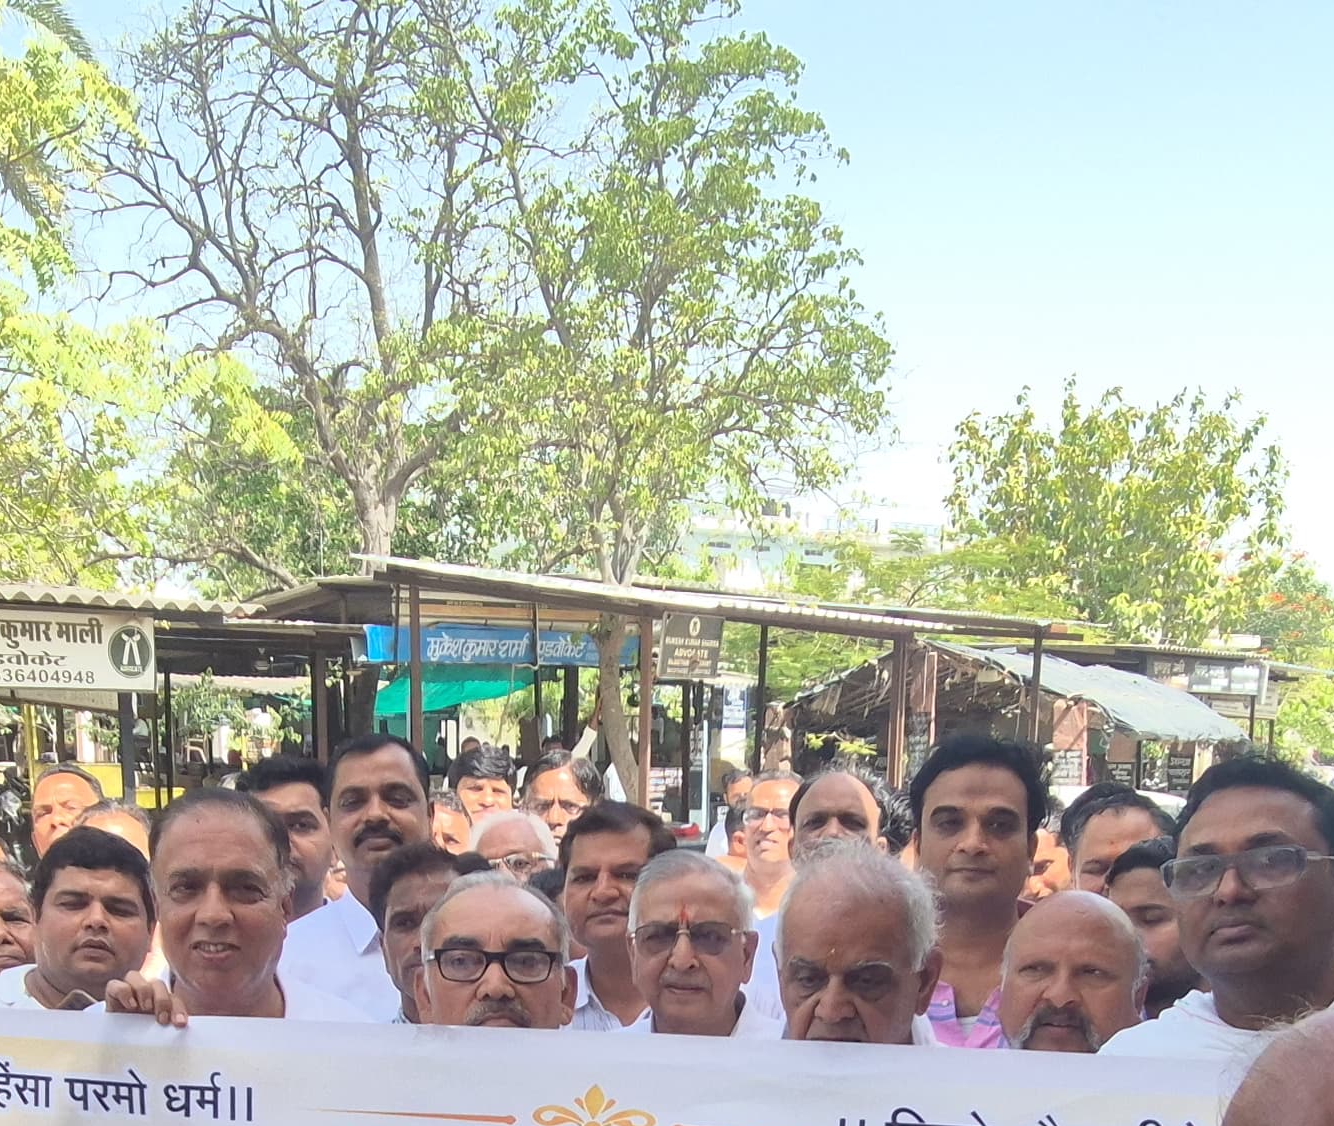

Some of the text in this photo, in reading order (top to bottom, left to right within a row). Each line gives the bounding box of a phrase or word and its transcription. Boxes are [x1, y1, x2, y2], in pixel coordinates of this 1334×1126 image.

[0, 618, 52, 648] कुमार
[56, 617, 103, 644] माली
[427, 632, 462, 661] मुकेश
[461, 636, 496, 661] कुमार
[499, 632, 530, 658] शर्मा
[64, 1069, 147, 1116] परमो
